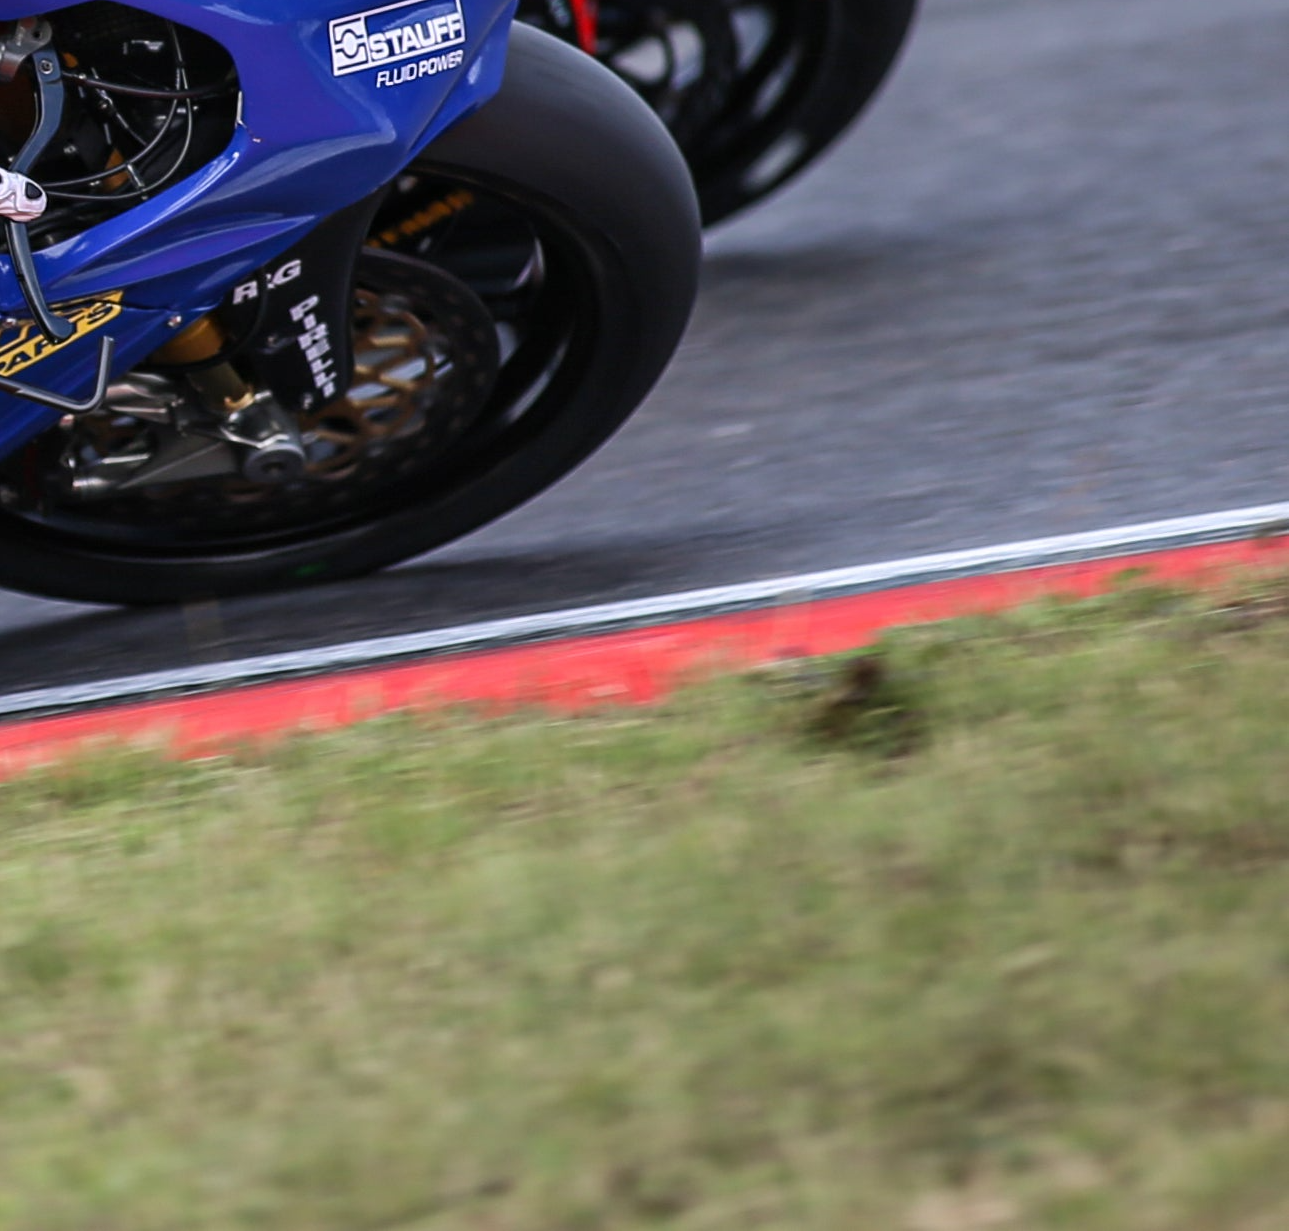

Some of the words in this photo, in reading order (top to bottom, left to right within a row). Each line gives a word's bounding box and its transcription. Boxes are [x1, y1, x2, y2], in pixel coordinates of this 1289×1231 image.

[368, 11, 464, 62] STAUFF
[375, 63, 418, 89] FLUID
[417, 49, 464, 78] POWER
[288, 294, 338, 399] PIRELLI
